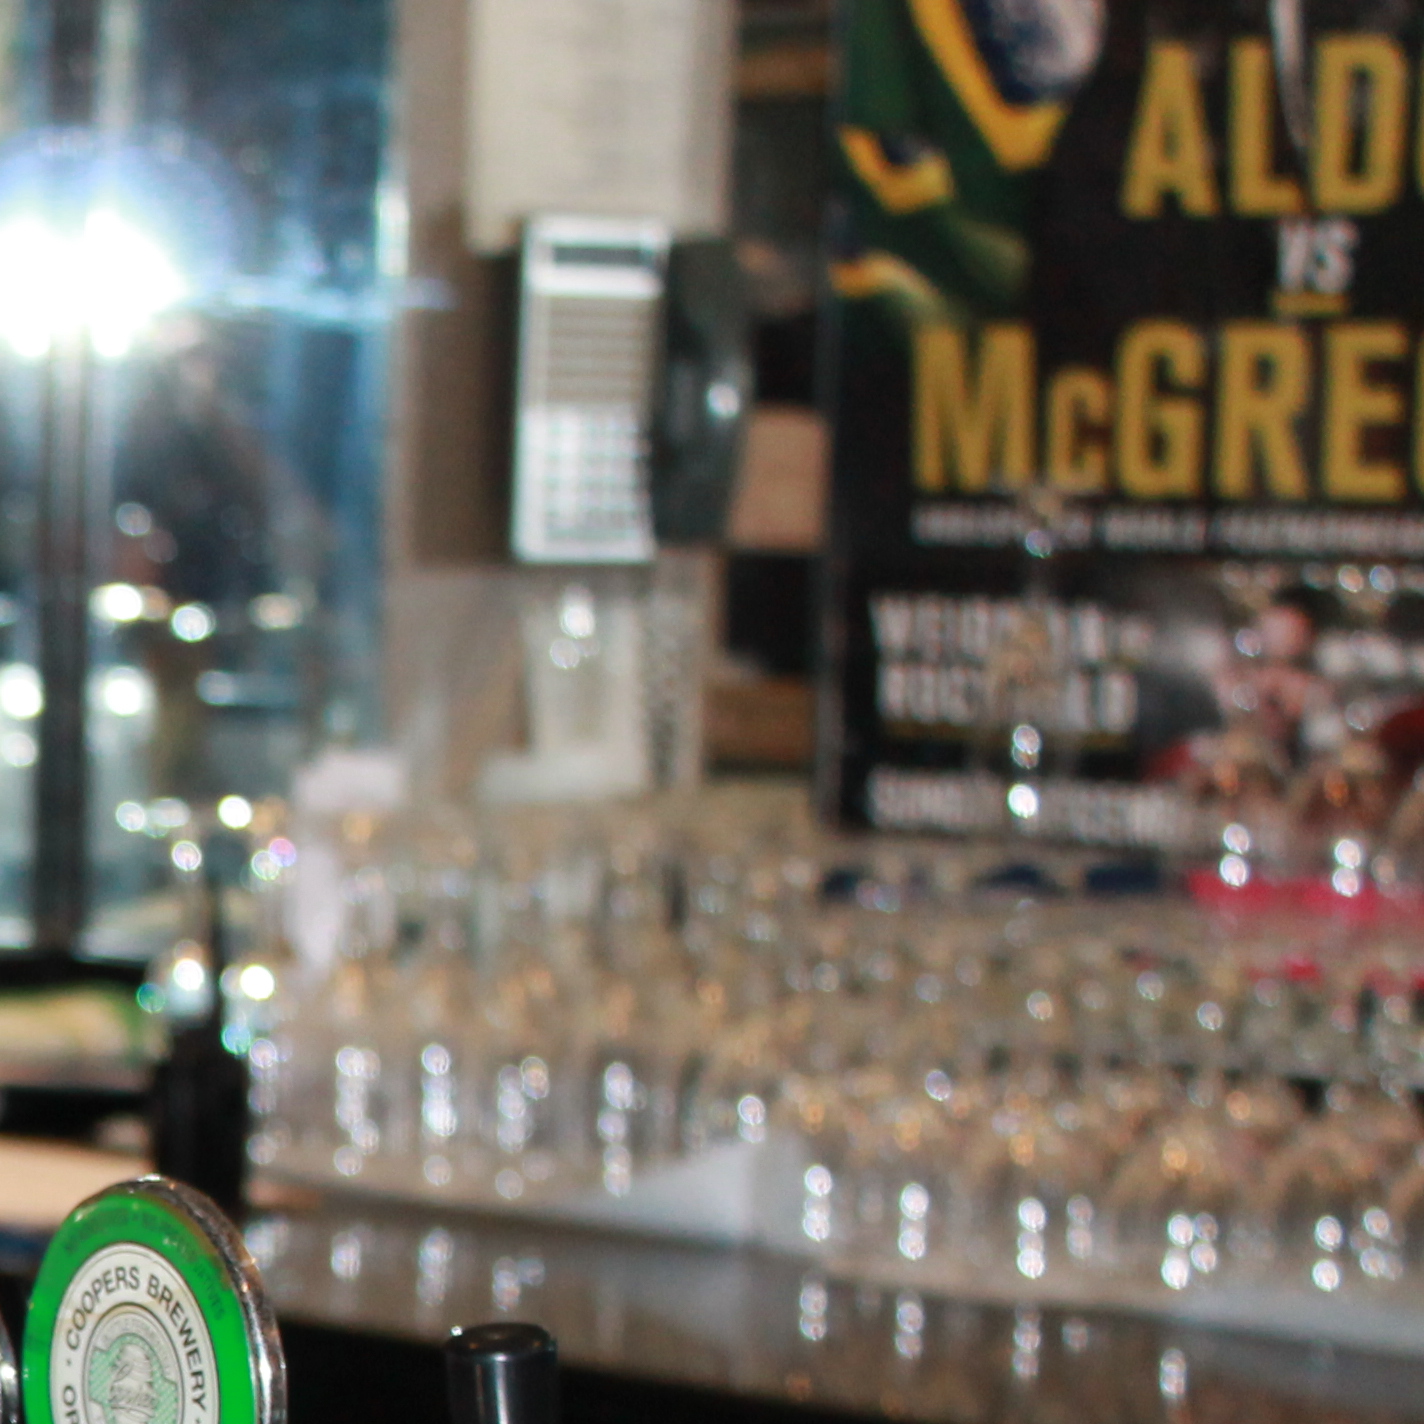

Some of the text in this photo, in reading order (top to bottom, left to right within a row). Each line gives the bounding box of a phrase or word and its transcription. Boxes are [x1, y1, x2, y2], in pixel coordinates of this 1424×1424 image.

[1119, 29, 1424, 219] ALD
[1276, 215, 1358, 295] VS
[908, 317, 1424, 501] McGRE
[65, 1265, 141, 1352] COOPERS
[147, 1272, 209, 1413] BREWERY
